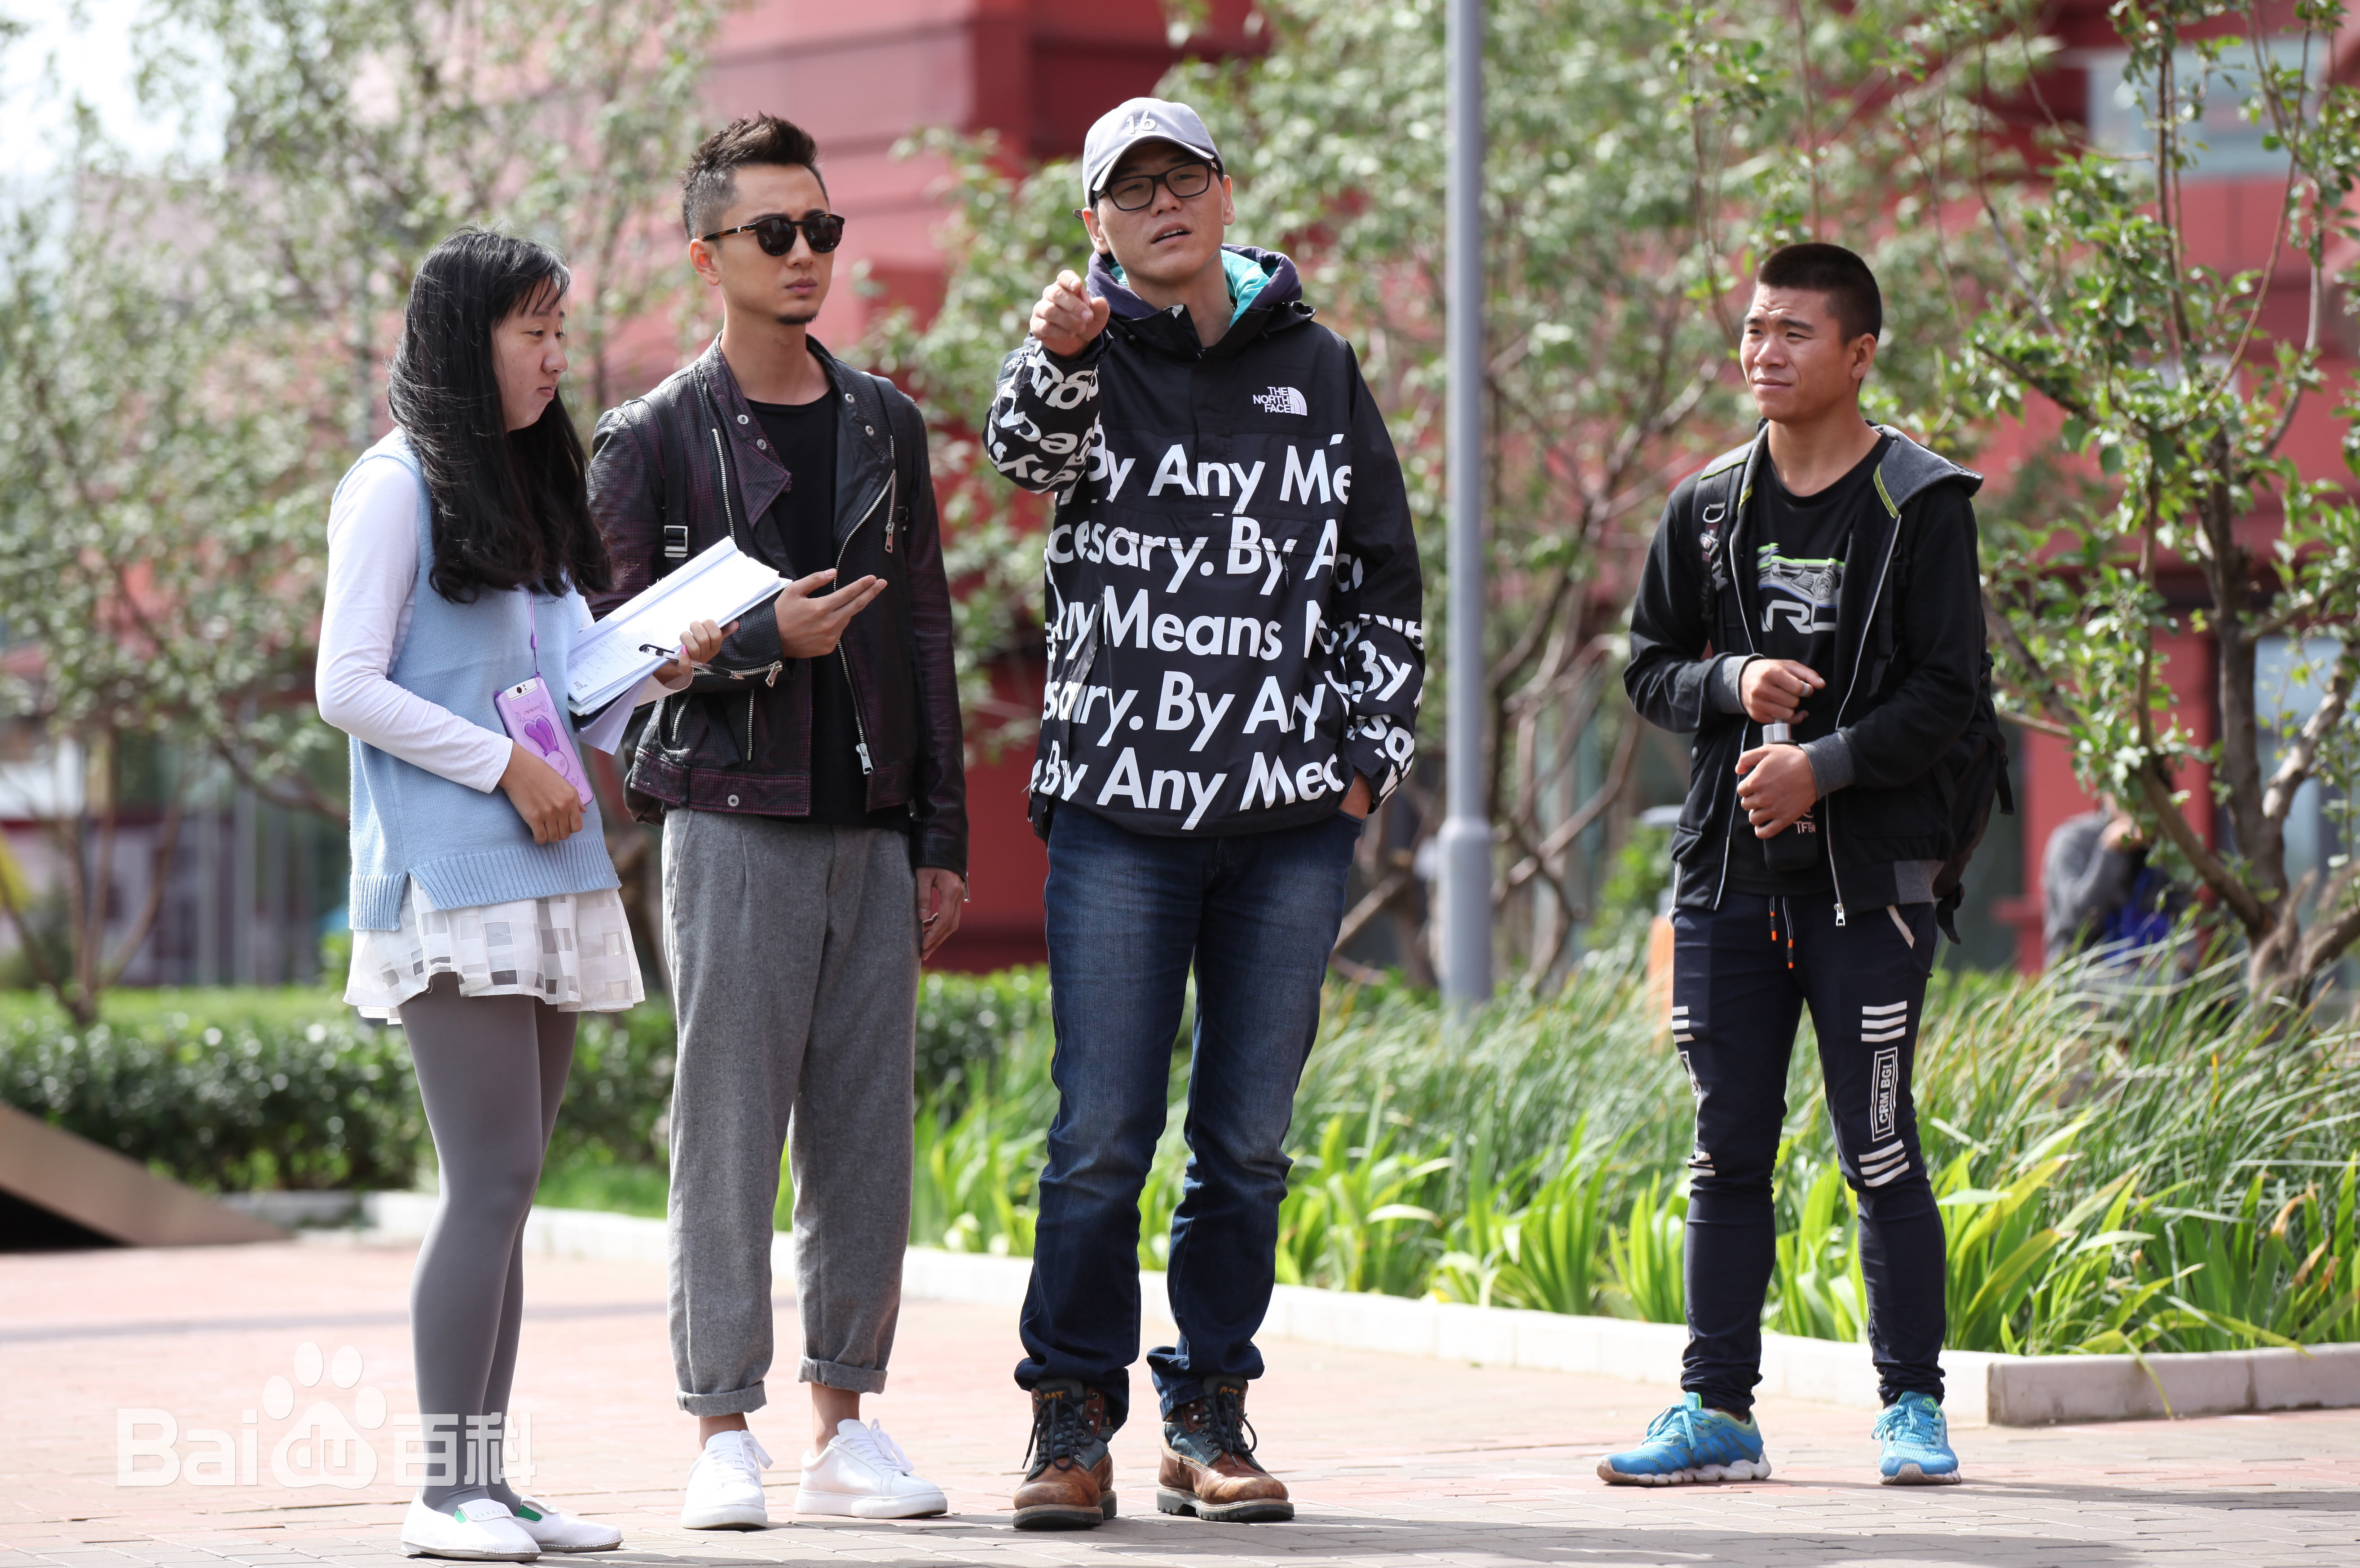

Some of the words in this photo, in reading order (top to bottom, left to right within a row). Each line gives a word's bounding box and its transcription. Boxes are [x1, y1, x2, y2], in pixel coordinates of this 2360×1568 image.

[1126, 110, 1156, 134] 16
[1253, 395, 1290, 405] NORTH
[1264, 403, 1290, 413] FACE
[1267, 387, 1288, 396] THE
[1147, 444, 1266, 515] Any
[1227, 517, 1297, 595] By
[1103, 586, 1282, 661] Means
[1155, 671, 1235, 752] By
[1242, 676, 1326, 743] Ay
[1096, 747, 1227, 830] Any
[1879, 1091, 1889, 1124] CRM
